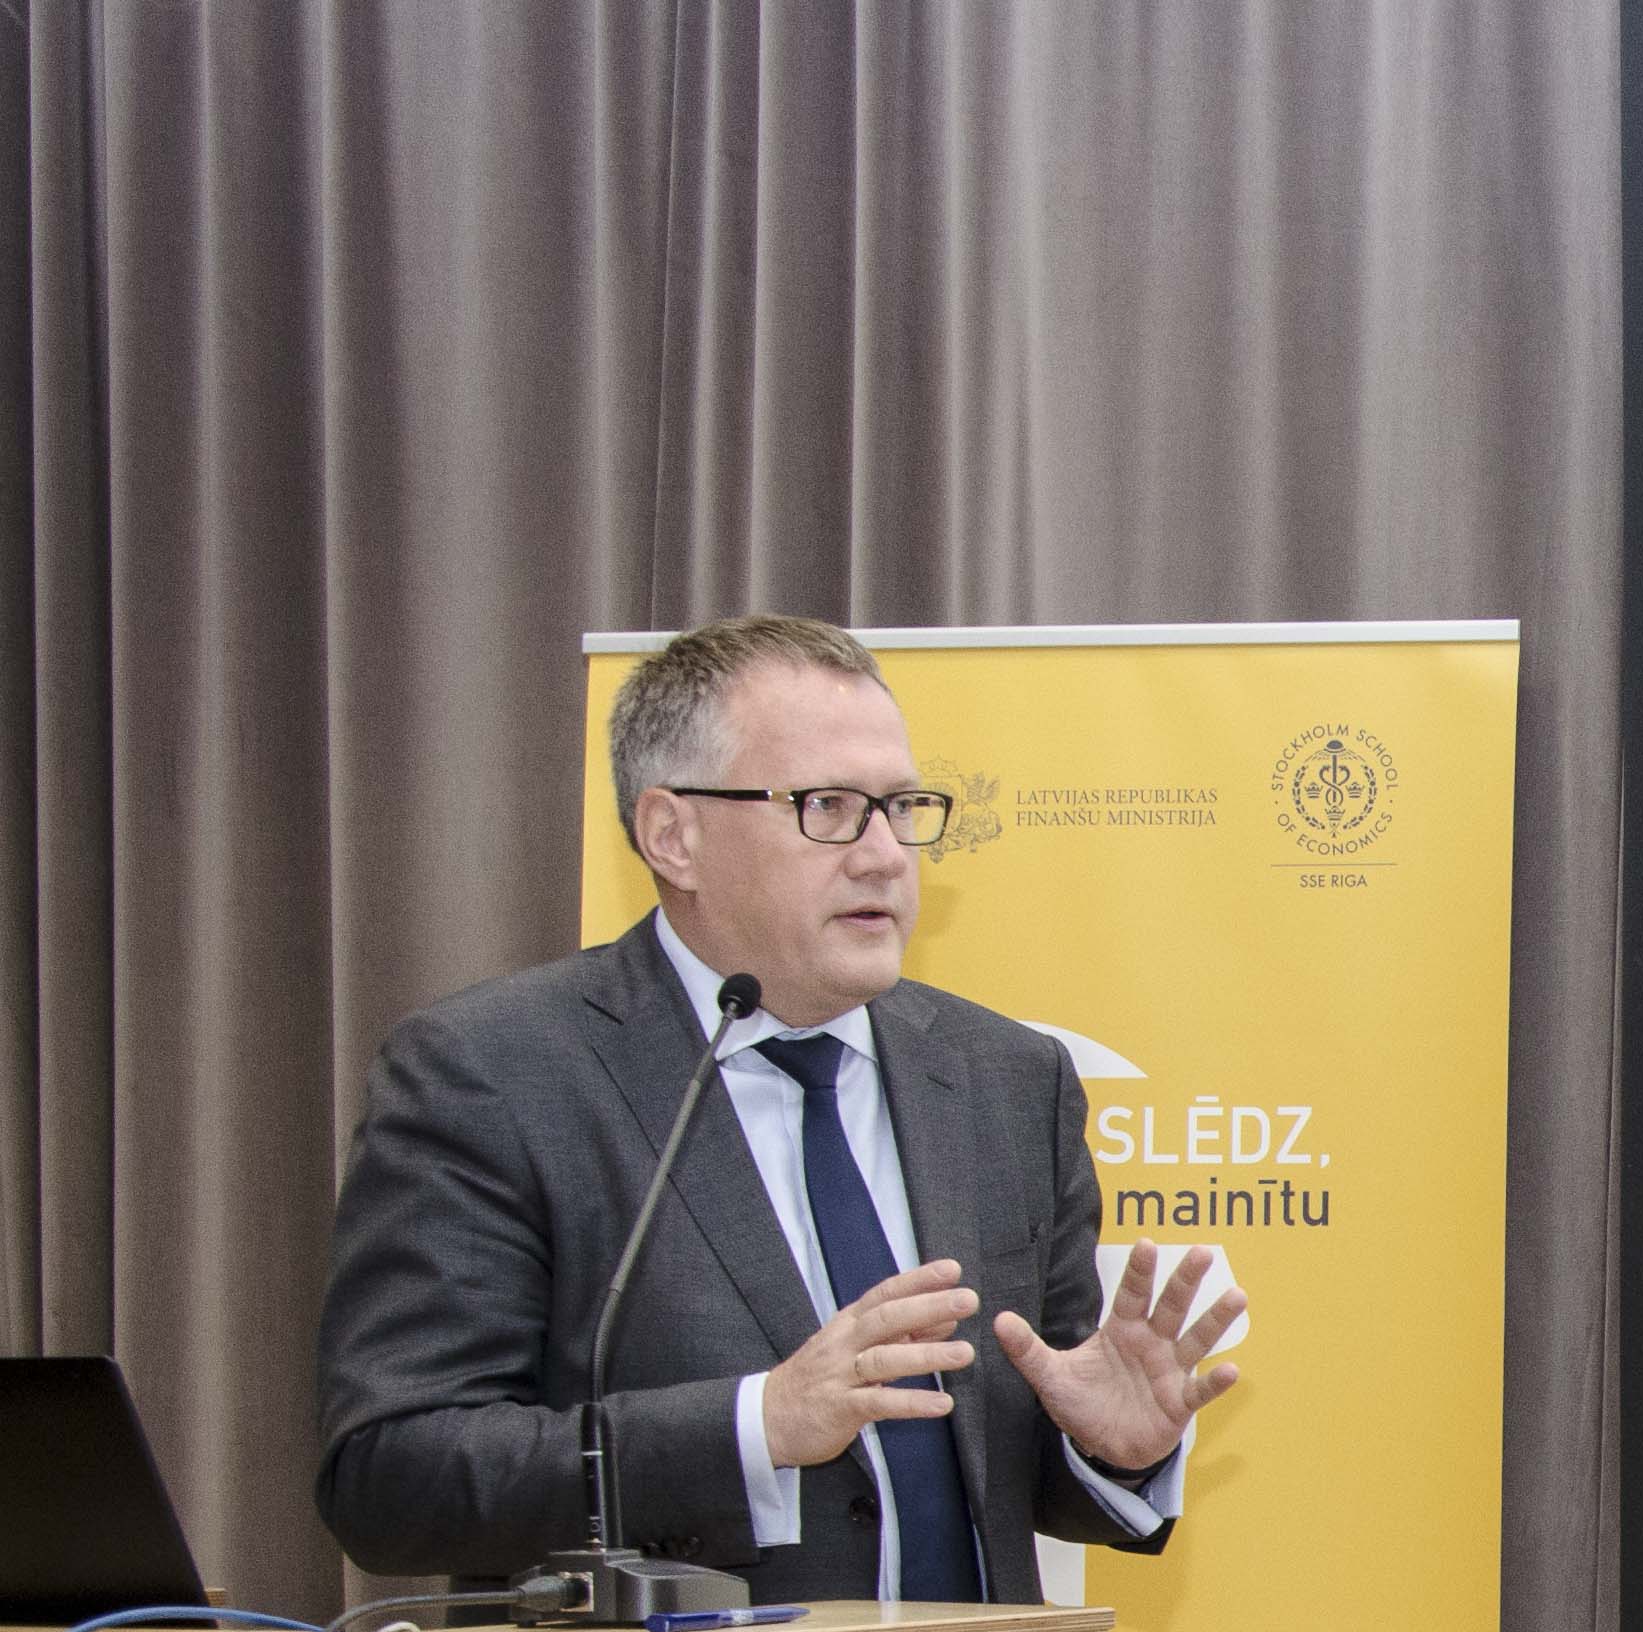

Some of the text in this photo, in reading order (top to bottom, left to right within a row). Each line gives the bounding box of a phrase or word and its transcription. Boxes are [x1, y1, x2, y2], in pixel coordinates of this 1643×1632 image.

[1271, 724, 1399, 791] STOCKHOLM SCHOOL
[1016, 788, 1218, 806] LATVIJAS REPUBLIKAS
[1016, 808, 1217, 827] FINANŠU MINISTRIJA
[1277, 812, 1392, 856] OF ECONOMICS
[1300, 874, 1368, 888] SSE RIGA
[1095, 1096, 1330, 1168] SLĒDZ,
[1116, 1177, 1329, 1226] mainītu
